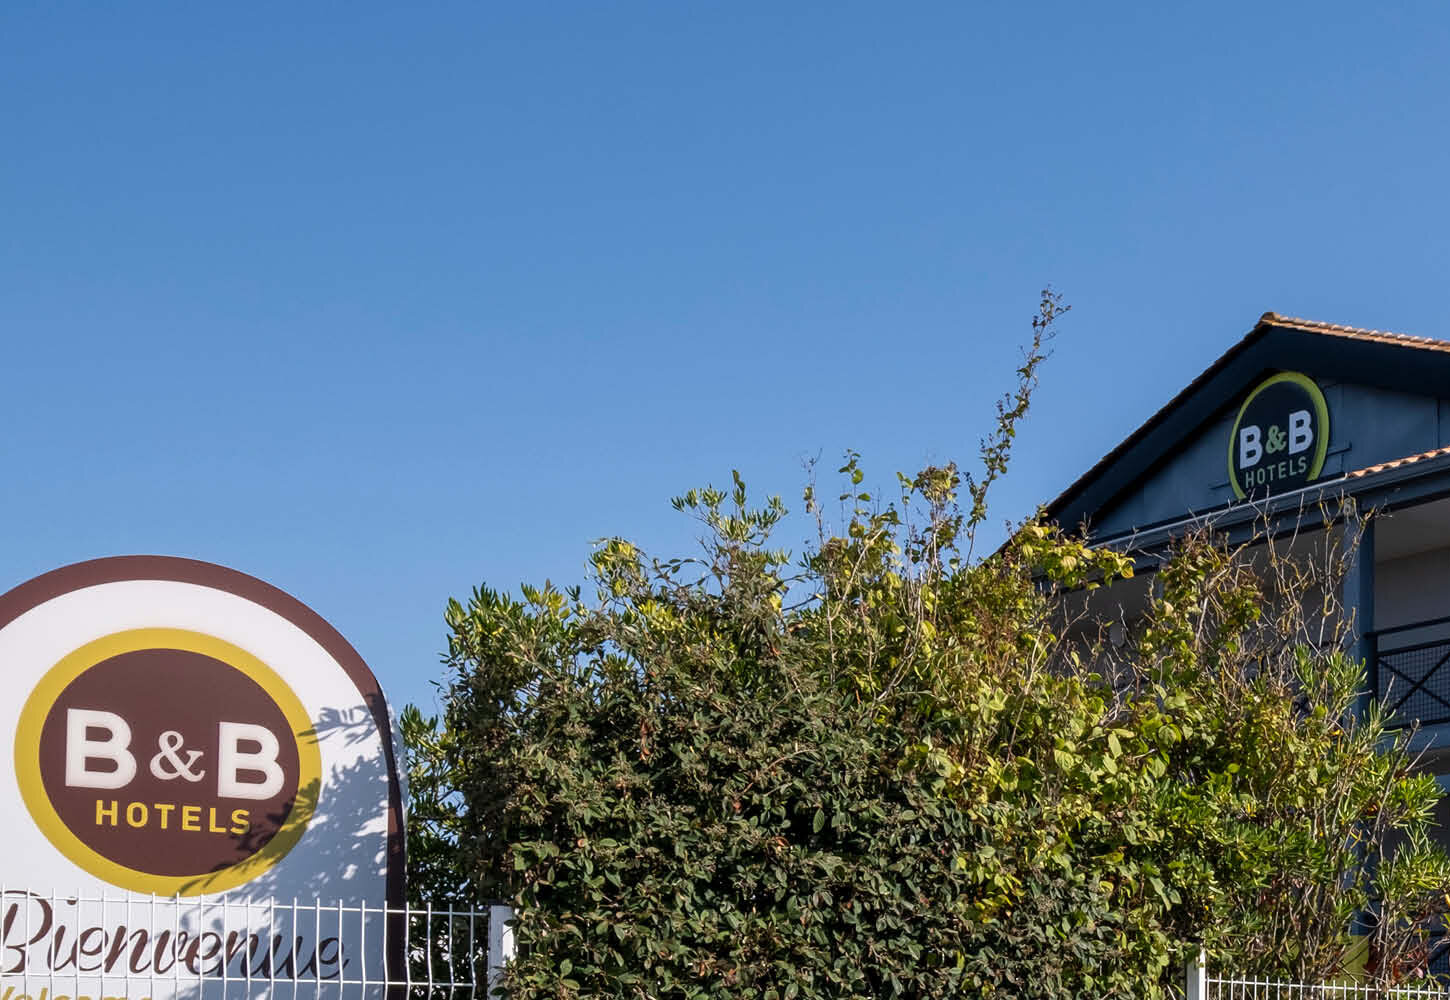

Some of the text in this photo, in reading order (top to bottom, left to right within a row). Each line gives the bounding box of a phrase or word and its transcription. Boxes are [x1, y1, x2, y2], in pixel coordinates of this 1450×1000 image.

[1240, 410, 1313, 470] B&B
[1245, 456, 1307, 488] HOTELS
[65, 708, 285, 800] B&B
[96, 799, 250, 835] HOTELS
[0, 890, 350, 980] Bienvenue
